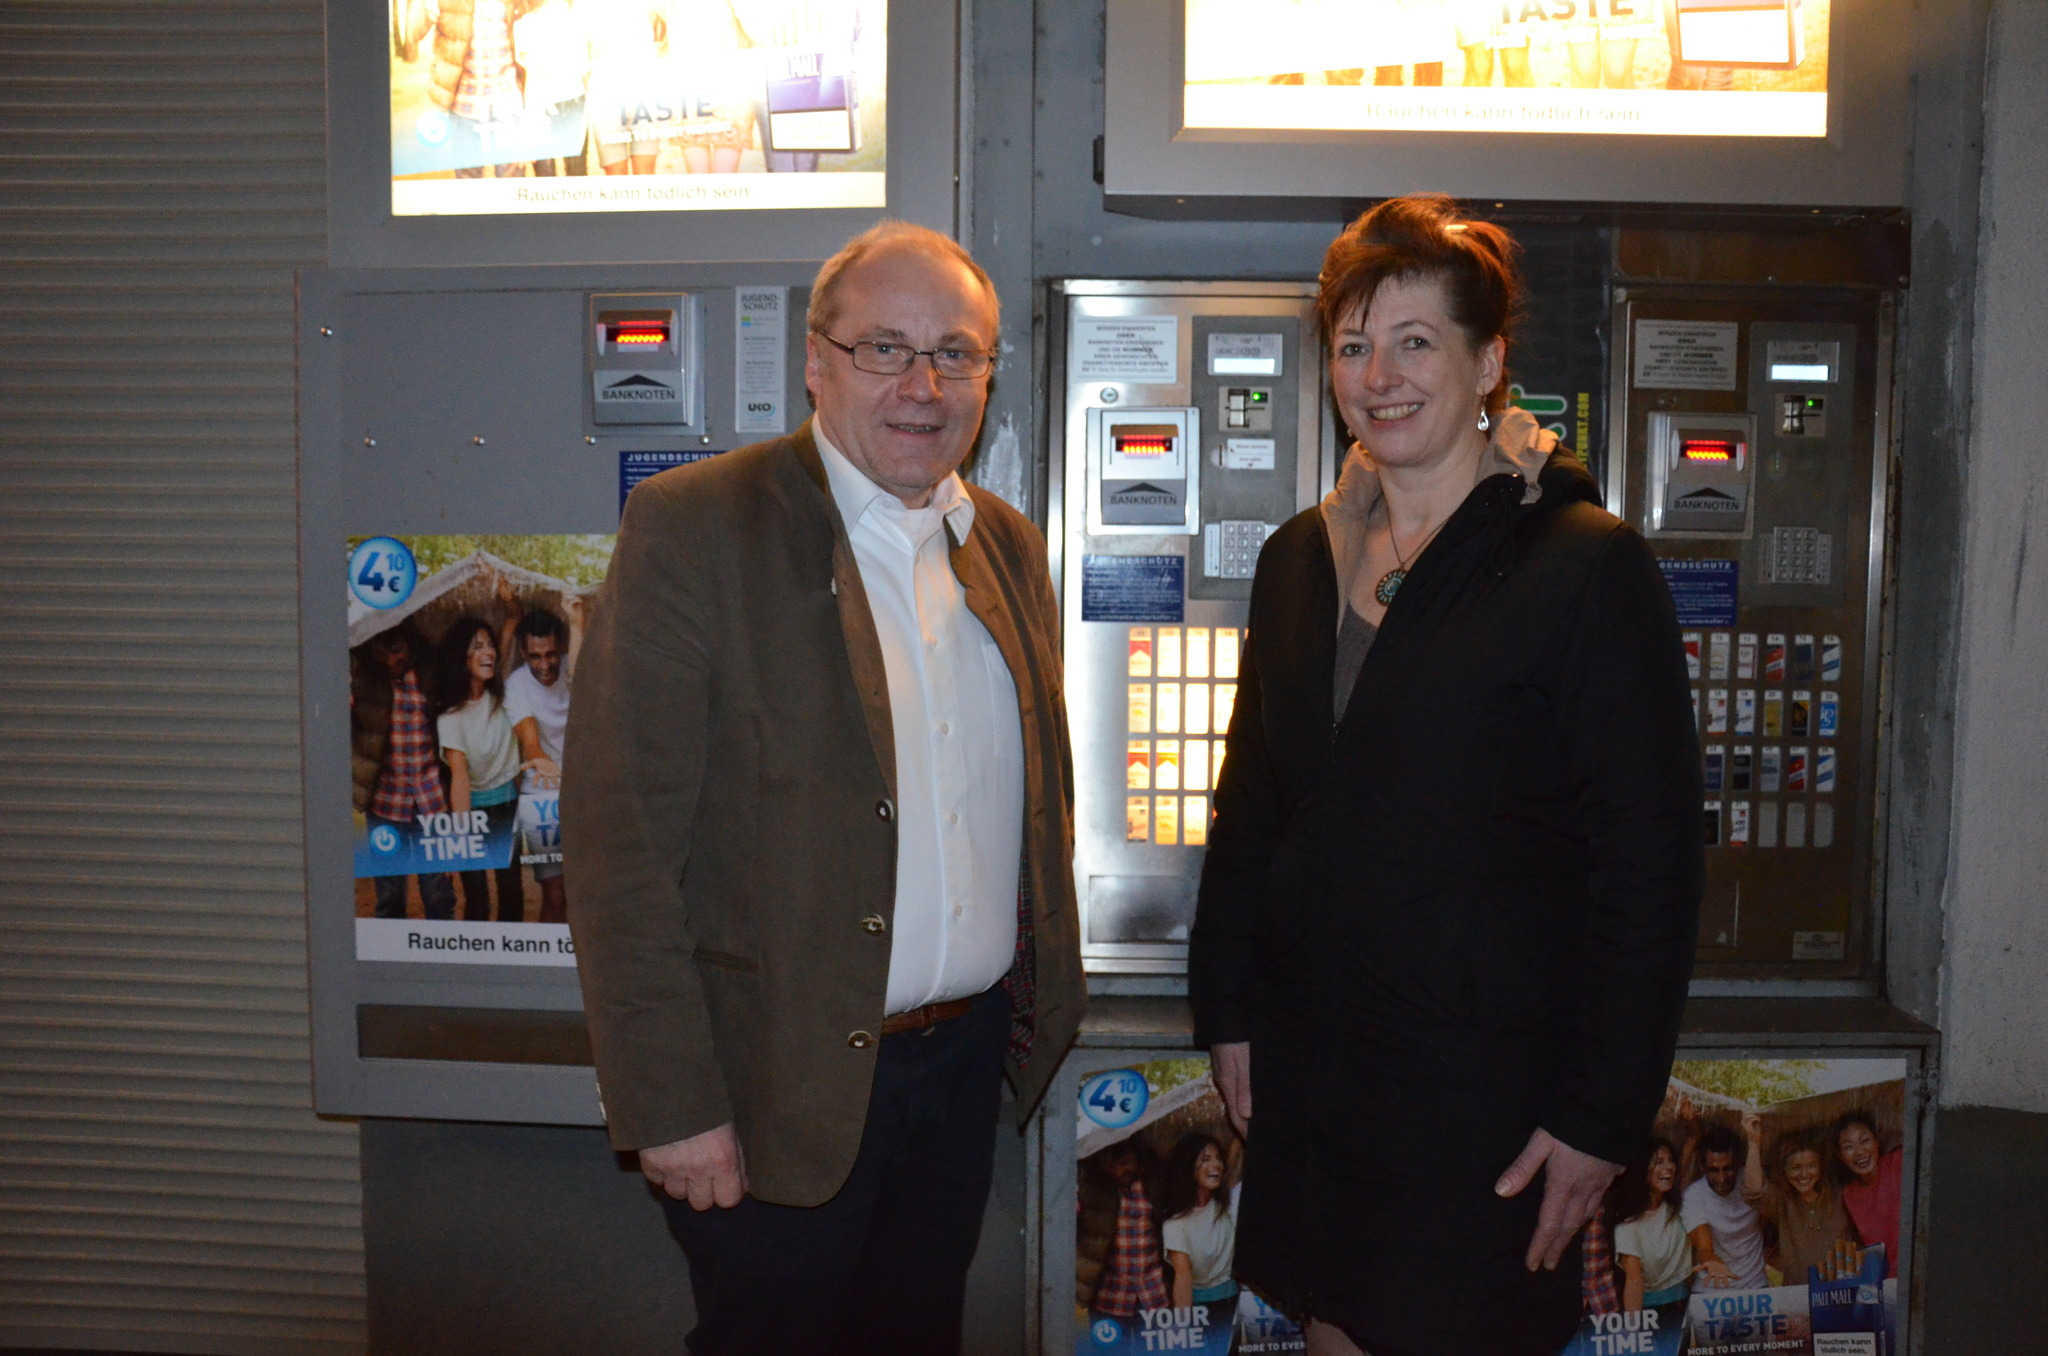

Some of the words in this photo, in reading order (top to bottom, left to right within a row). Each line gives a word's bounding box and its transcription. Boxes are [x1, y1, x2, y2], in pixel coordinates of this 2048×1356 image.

[618, 94, 714, 126] TASTE
[517, 188, 592, 202] Rauchen
[599, 187, 640, 200] kann
[602, 389, 675, 400] BANKNOTEN
[1110, 495, 1178, 505] BANKNOTEN
[1673, 500, 1740, 512] BANKNOTEN
[358, 551, 385, 592] 4
[386, 552, 404, 572] 10
[1658, 561, 1731, 570] GENDSCHUTZ
[416, 810, 490, 837] YOUR
[419, 834, 486, 862] TIME
[520, 854, 548, 865] MORE
[408, 933, 495, 951] Rauchen
[502, 936, 550, 953] kann
[558, 937, 576, 954] tö
[1088, 1079, 1116, 1112] 4
[1118, 1080, 1137, 1094] 10
[1702, 1293, 1774, 1318] YOUR
[1830, 1288, 1853, 1305] MALL
[1139, 1305, 1210, 1330] YOUR
[1588, 1308, 1659, 1335] YOUR
[1703, 1314, 1788, 1341] TASTE
[1140, 1327, 1205, 1351] TIME
[1238, 1343, 1266, 1353] MORE
[1267, 1342, 1280, 1351] TO
[1590, 1330, 1655, 1356] TIME
[1687, 1346, 1715, 1356] MORE
[1717, 1345, 1729, 1354] TO
[1730, 1342, 1761, 1353] EVERY
[1763, 1340, 1804, 1351] MOMENT
[1851, 1337, 1871, 1345] kann
